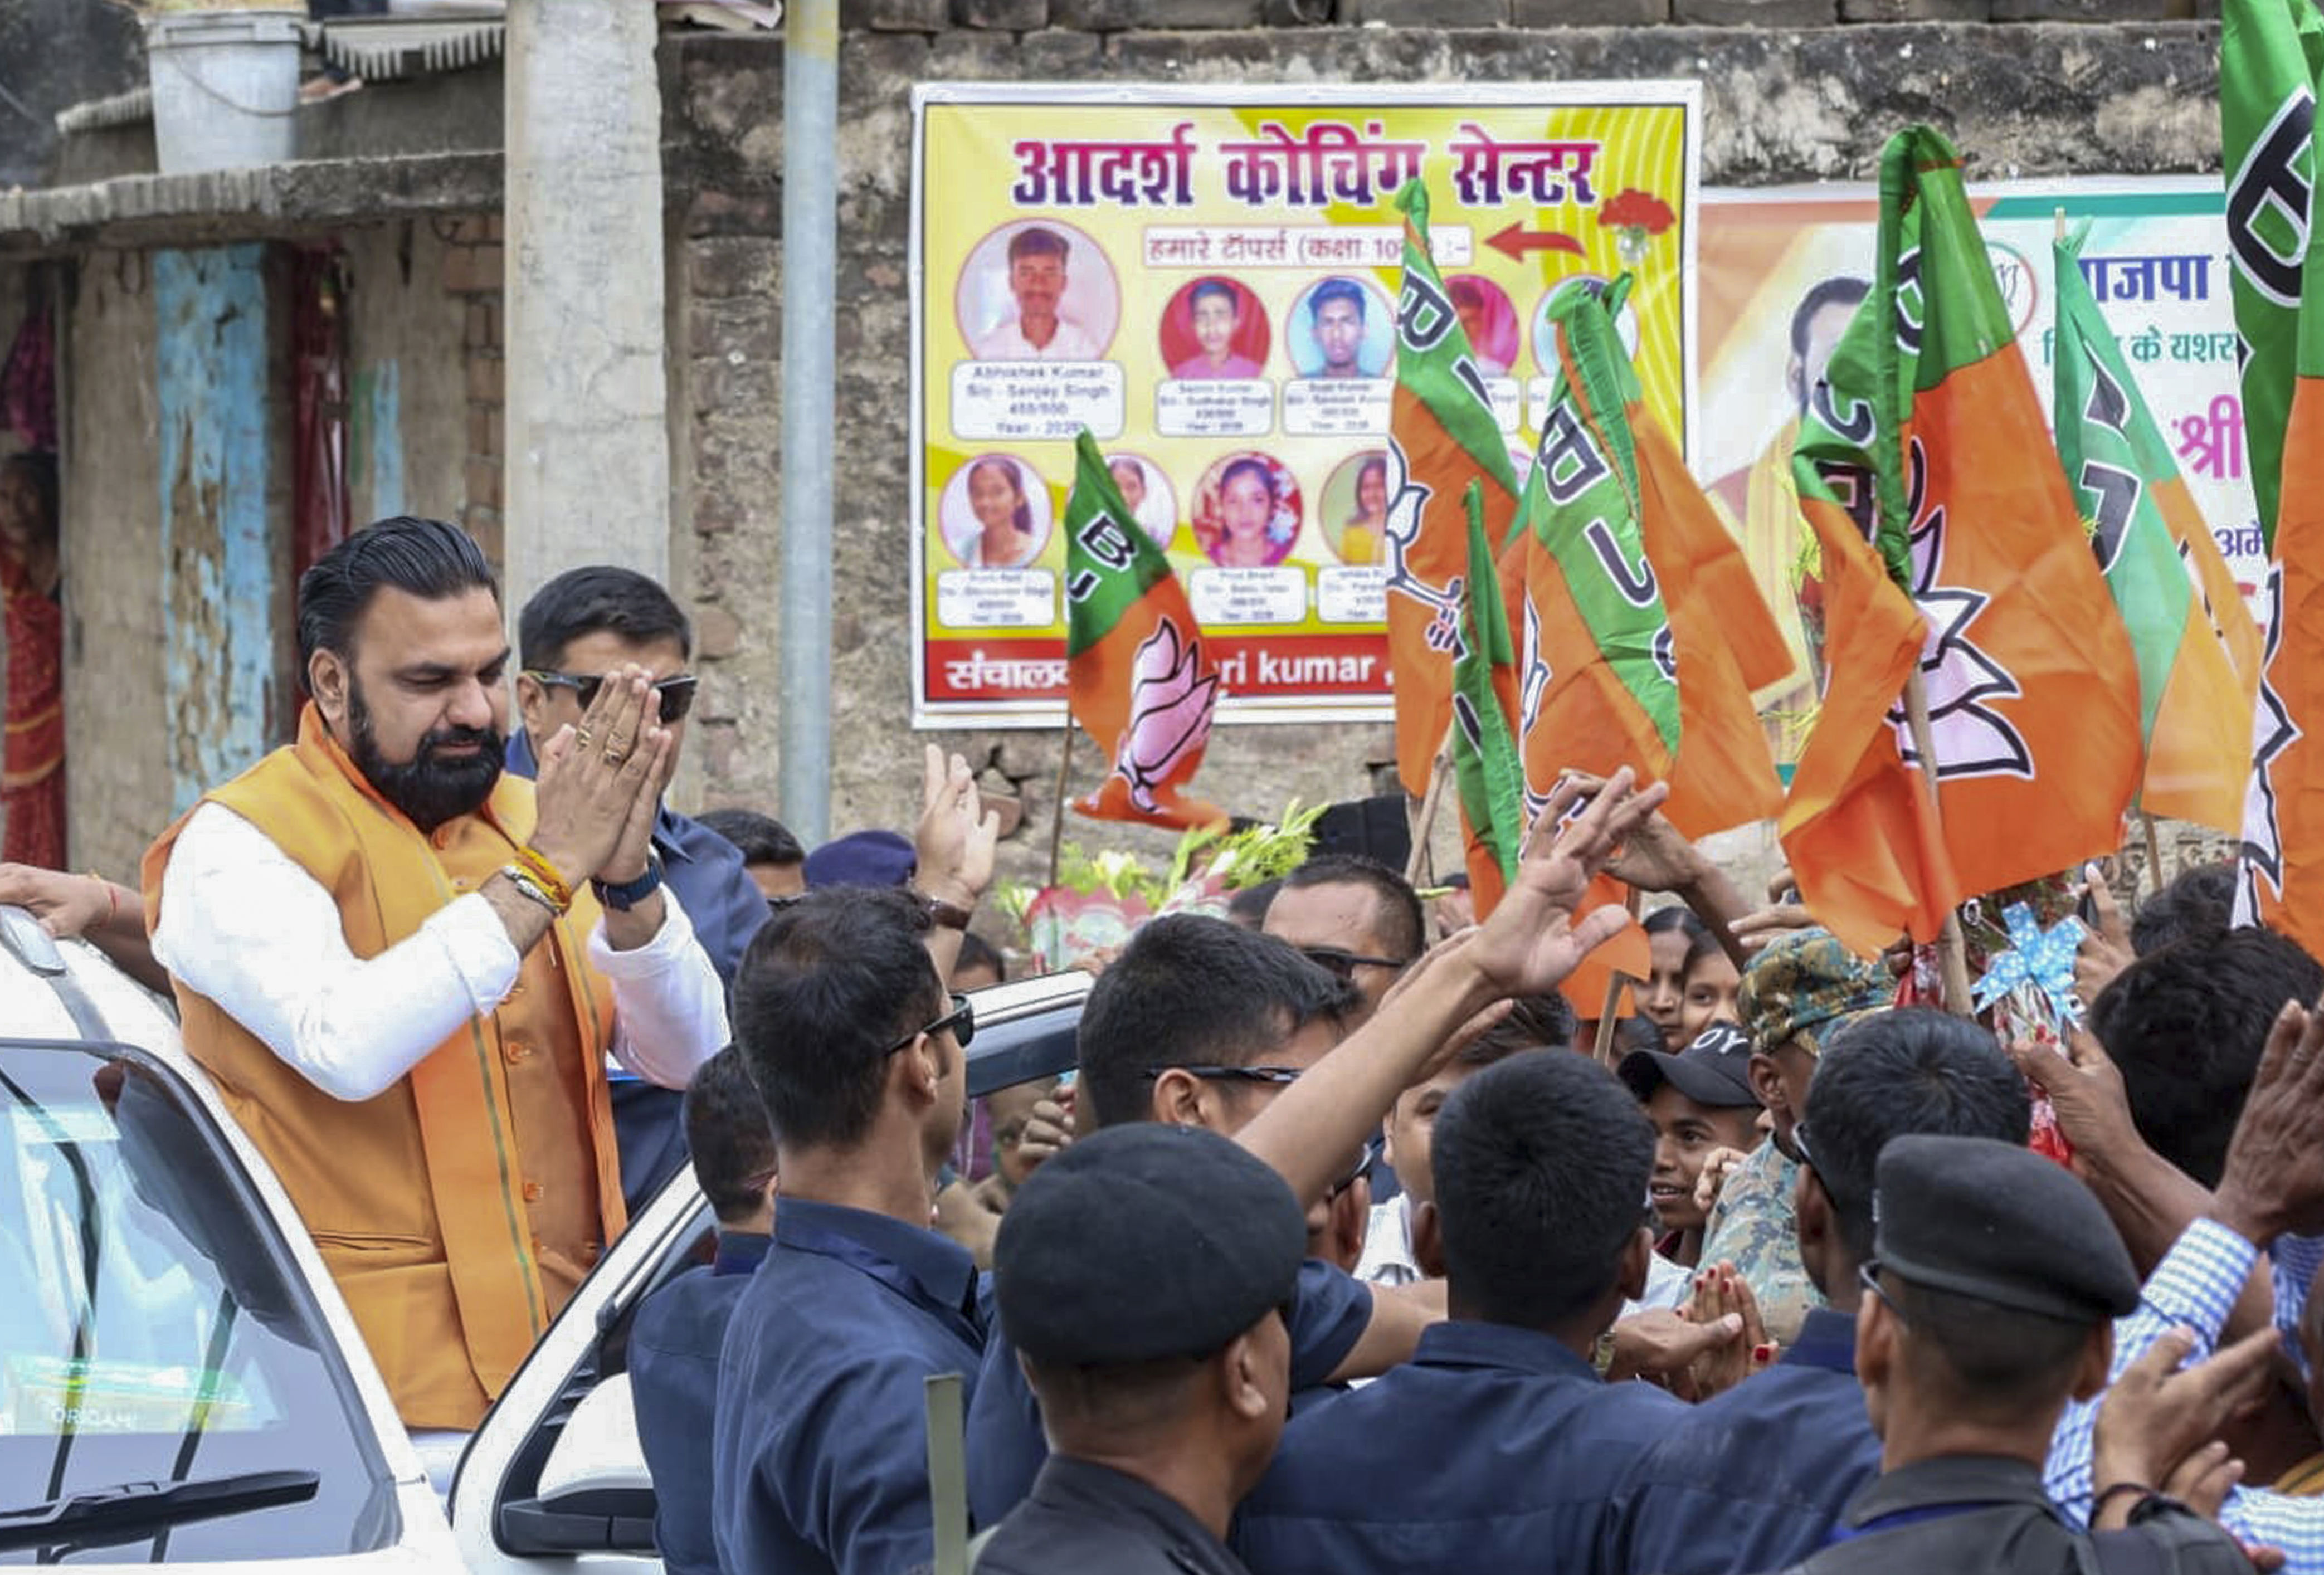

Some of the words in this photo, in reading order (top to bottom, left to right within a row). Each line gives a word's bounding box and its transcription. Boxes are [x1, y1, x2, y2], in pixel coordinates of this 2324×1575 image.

[1014, 122, 1197, 204] आदर्श
[1219, 122, 1425, 204] कोचिंग
[1448, 123, 1599, 204] सेन्टर
[1149, 230, 1211, 260] हमारे
[2078, 255, 2213, 301] ाजपा
[2130, 323, 2163, 363] के
[2171, 394, 2242, 479] श्री
[1212, 650, 1247, 685] ri
[1258, 649, 1376, 685] kumar
